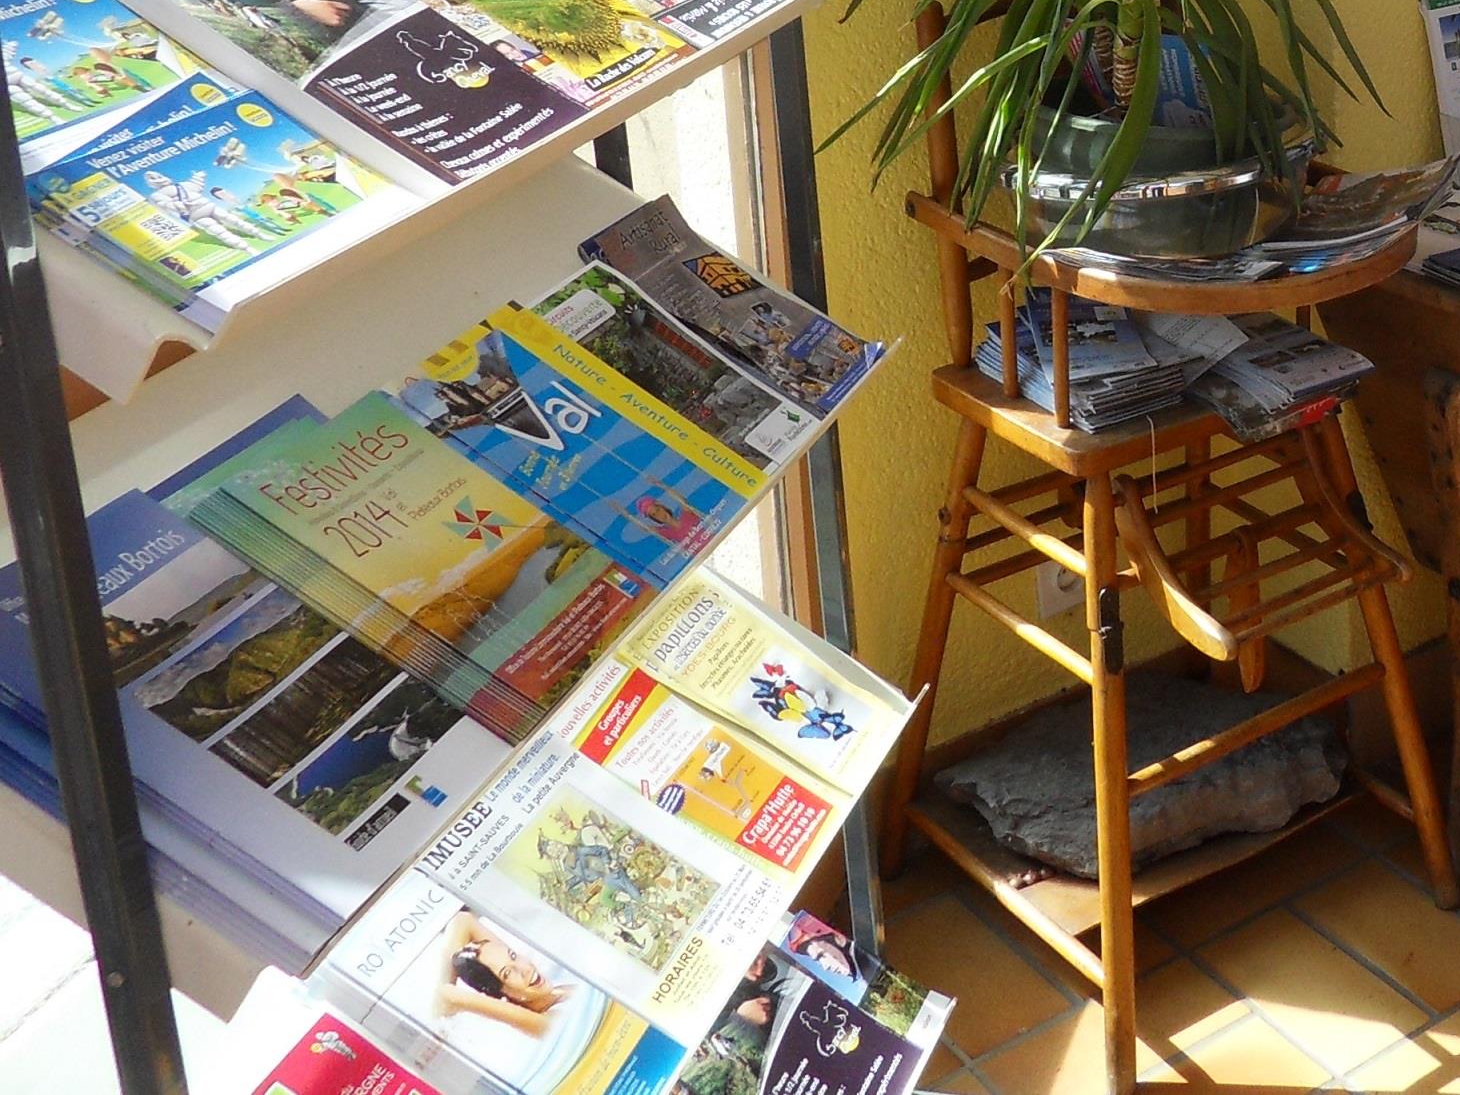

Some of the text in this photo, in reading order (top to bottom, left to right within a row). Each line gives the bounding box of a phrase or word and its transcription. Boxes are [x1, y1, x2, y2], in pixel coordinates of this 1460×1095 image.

[86, 134, 166, 170] Venez visiter
[503, 106, 554, 147] expérimentés
[106, 147, 179, 179] l'Aventure
[619, 211, 669, 250] Artisanat
[493, 380, 602, 451] Val
[552, 343, 758, 488] Nature Aventure Culture
[260, 423, 409, 515] Festivités
[127, 528, 186, 574] Bortois
[323, 500, 409, 559] 2014
[641, 588, 700, 649] EXPOSITION
[558, 664, 621, 738] ouvelles activités
[549, 752, 580, 785] Auvergne
[357, 889, 444, 977] ROATONIC
[651, 936, 704, 1005] HORAIRES
